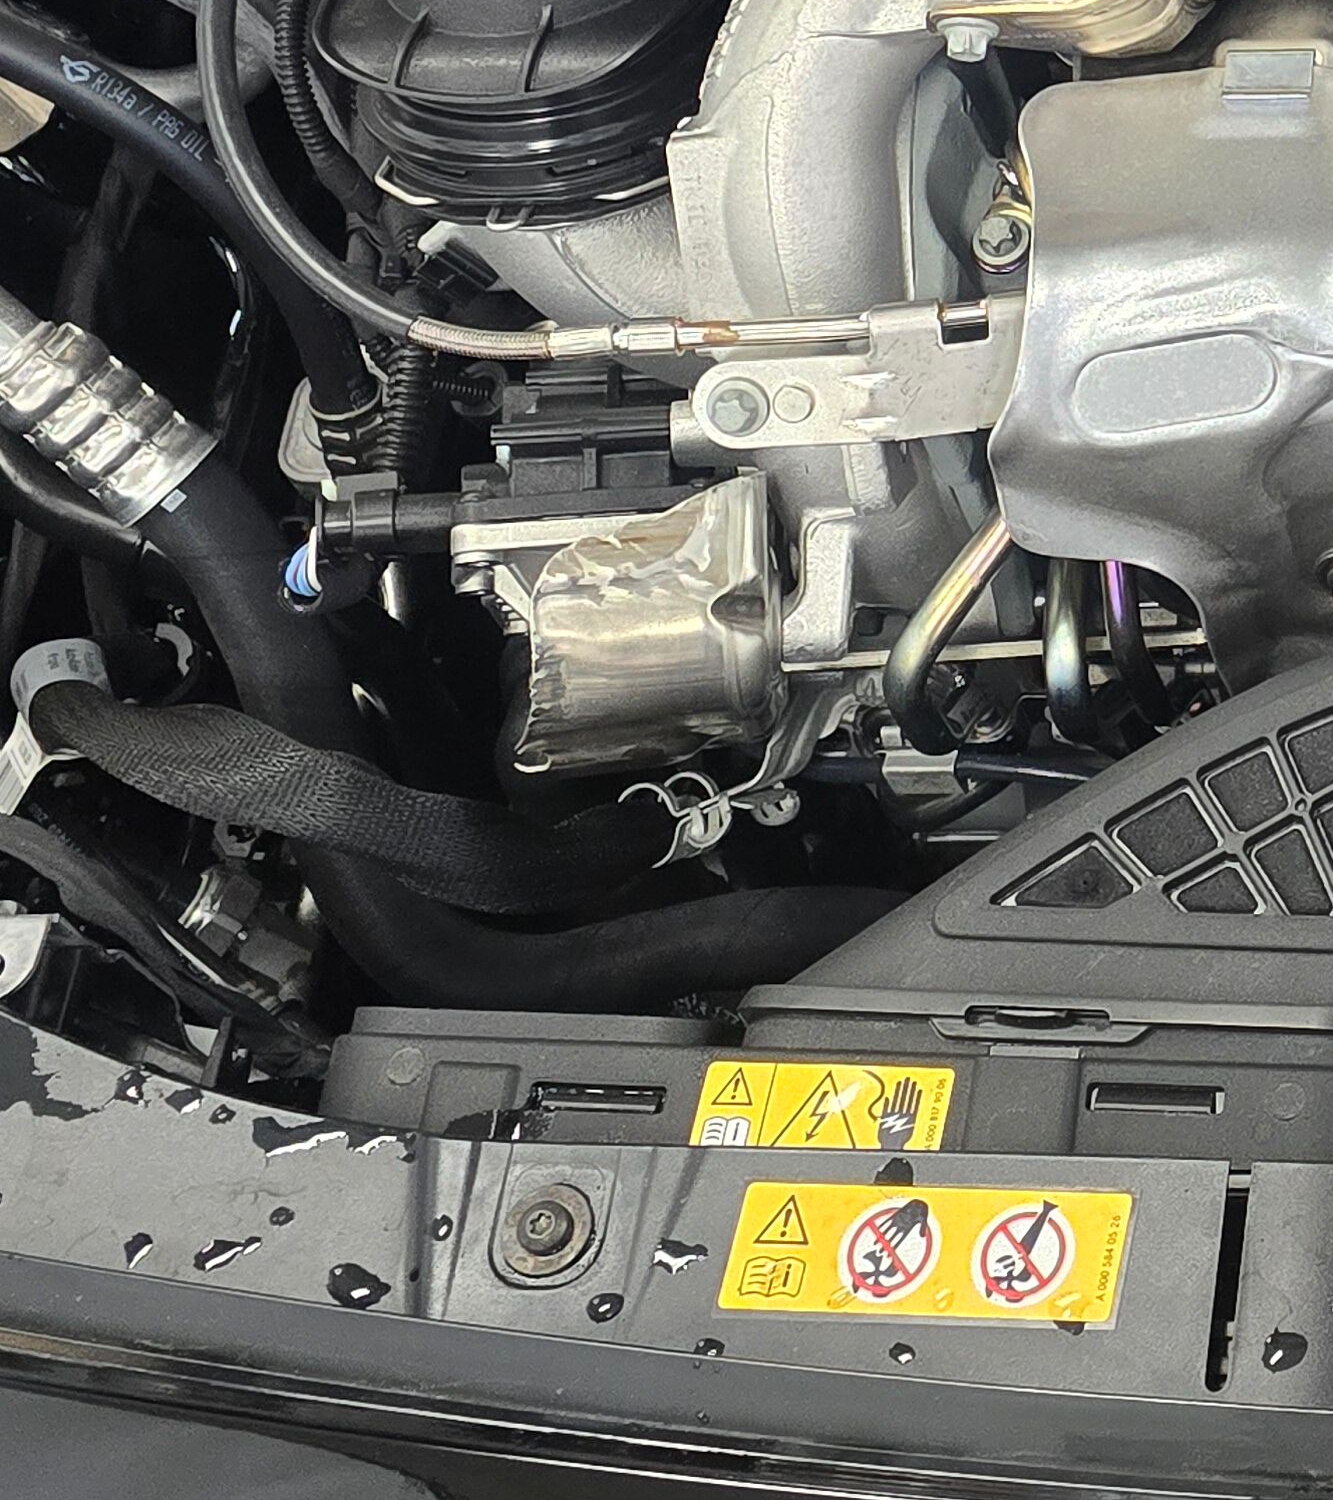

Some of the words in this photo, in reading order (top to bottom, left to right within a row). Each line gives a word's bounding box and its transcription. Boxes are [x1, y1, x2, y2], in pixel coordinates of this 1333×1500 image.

[91, 73, 138, 110] R134a
[180, 132, 210, 162] OIL
[924, 1124, 937, 1143] 000
[1110, 1214, 1121, 1228] 26
[1106, 1231, 1118, 1245] 05
[1102, 1248, 1114, 1268] 584
[1097, 1270, 1110, 1291] 000
[1094, 1293, 1105, 1302] A
